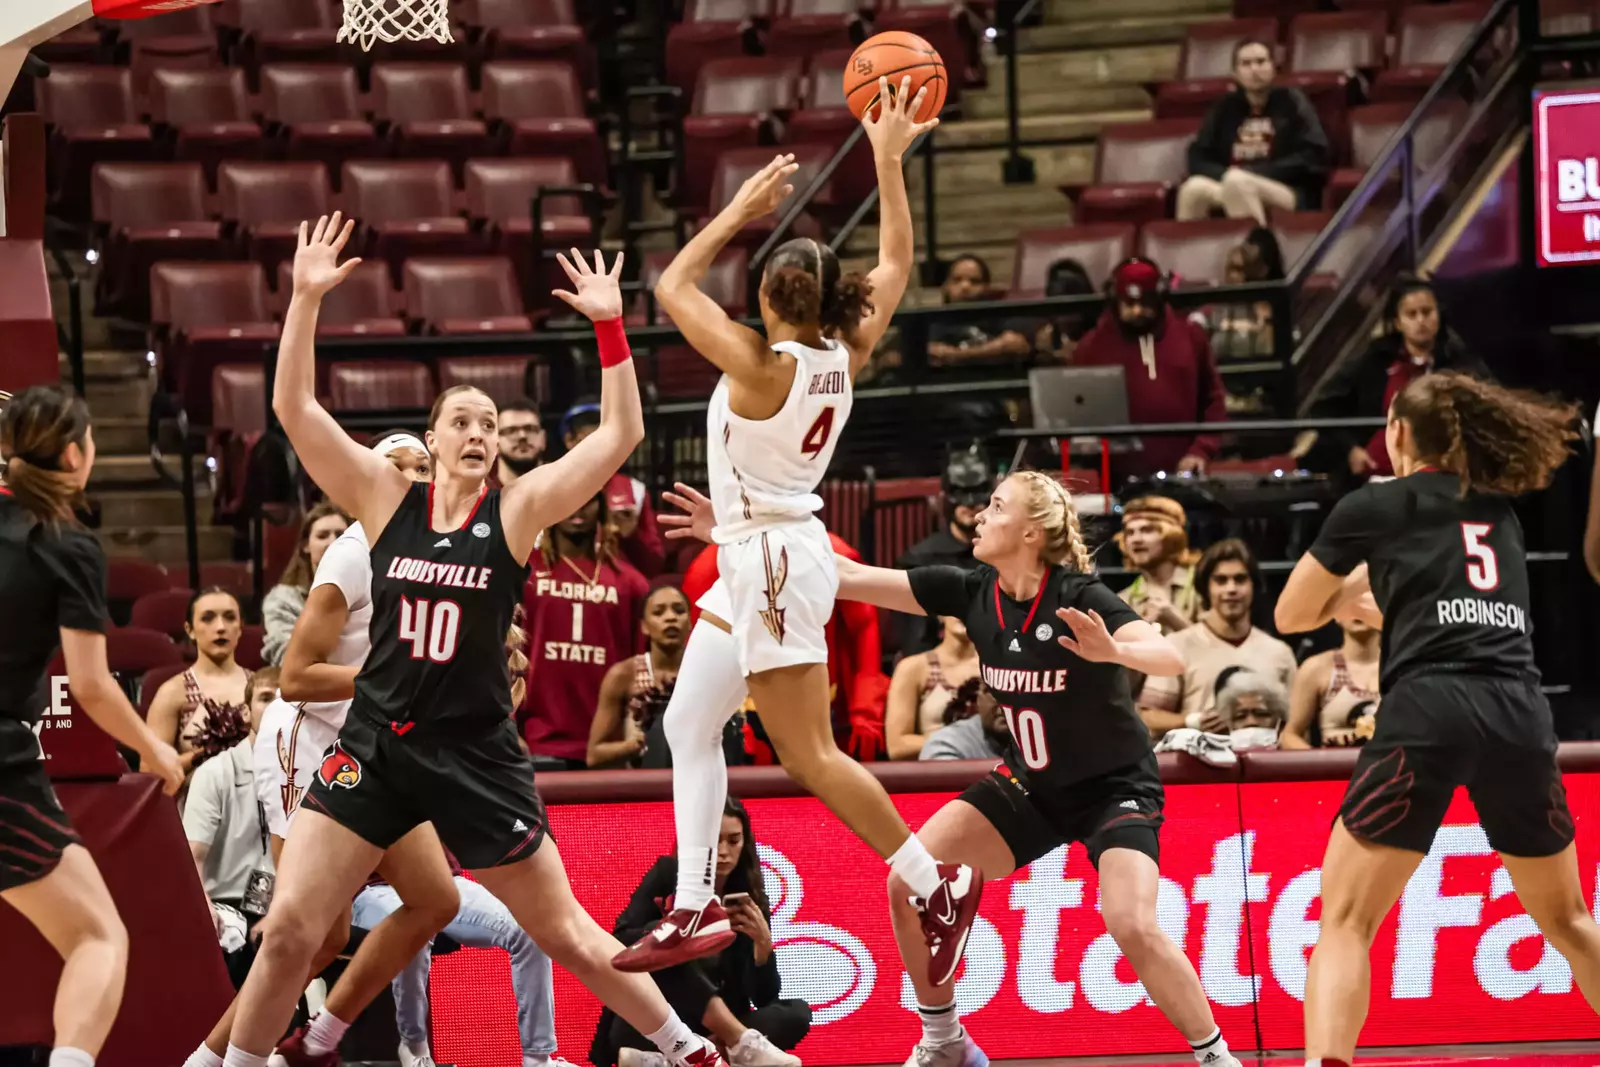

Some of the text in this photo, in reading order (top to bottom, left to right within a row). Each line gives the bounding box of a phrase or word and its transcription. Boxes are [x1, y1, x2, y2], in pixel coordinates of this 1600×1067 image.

[800, 404, 835, 462] 4
[386, 555, 493, 590] LOUISVILLE
[1460, 520, 1499, 592] 5
[398, 593, 463, 665] 40
[571, 602, 584, 642] 1
[1437, 597, 1526, 634] ROBINSON
[544, 640, 607, 665] STATE
[41, 675, 72, 715] E
[982, 663, 1069, 694] LOUISVILLE
